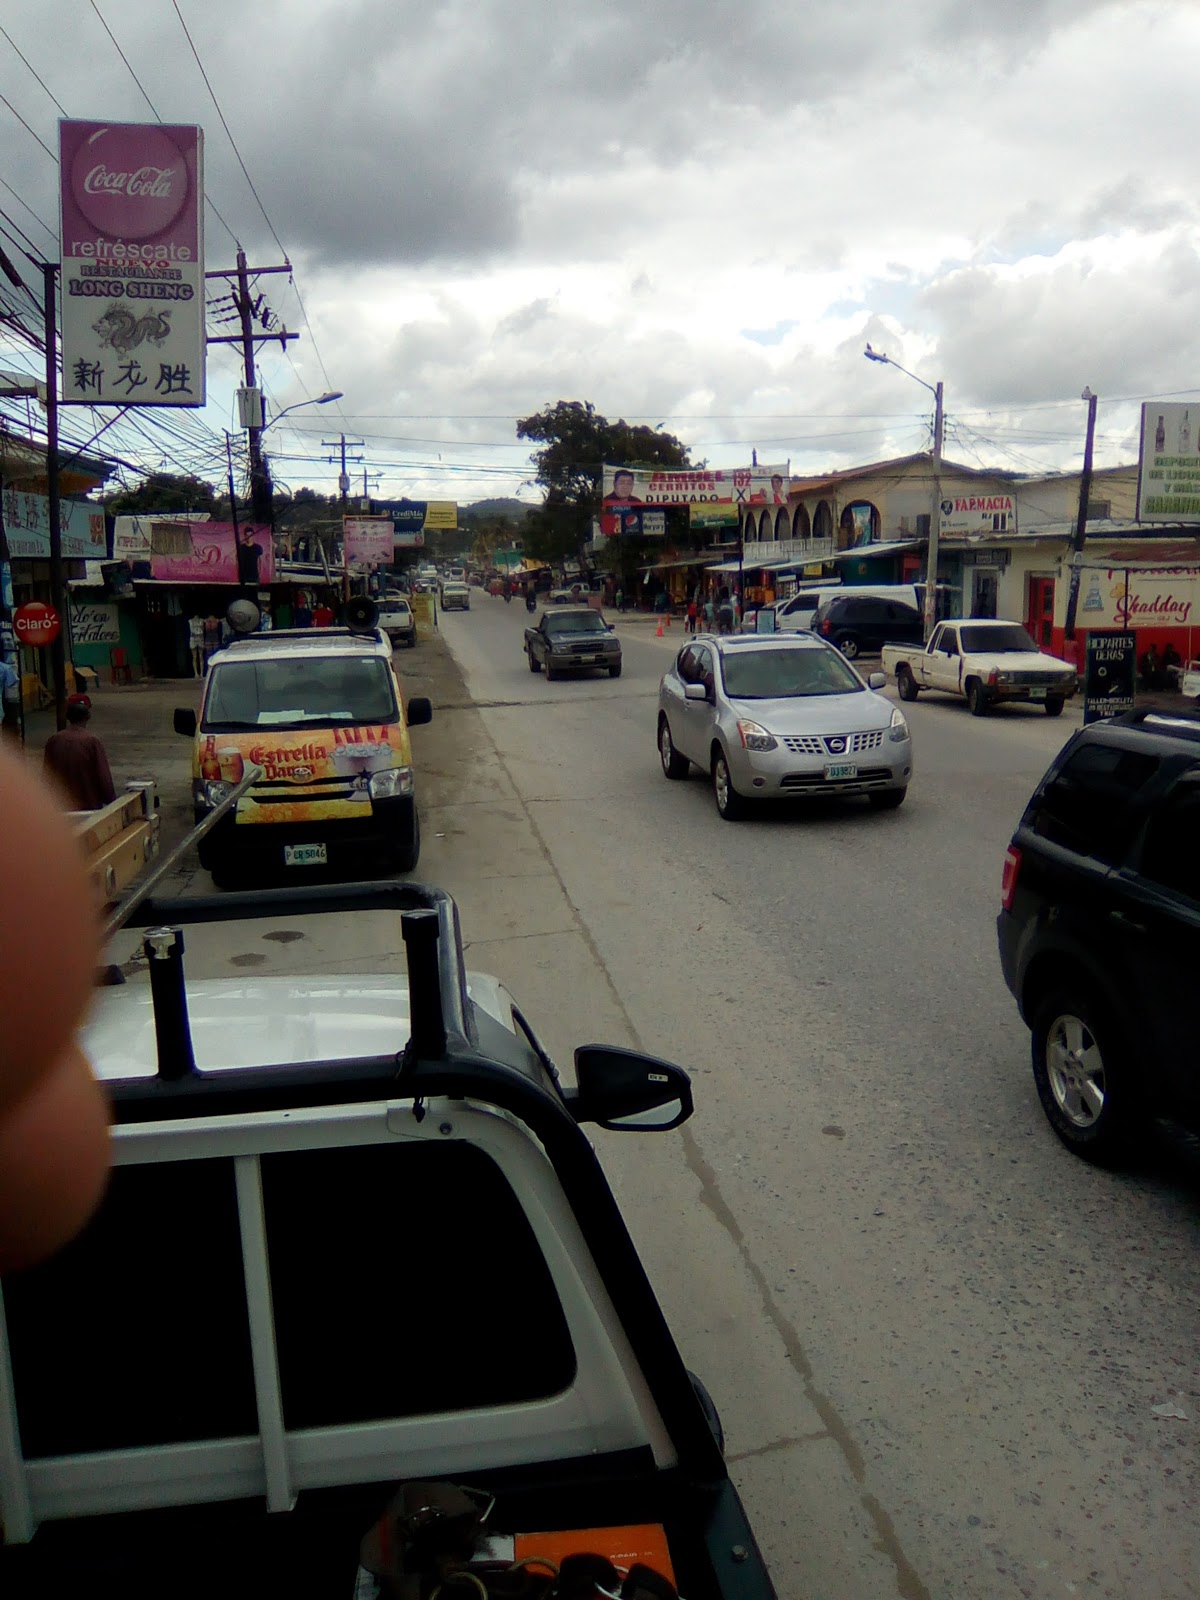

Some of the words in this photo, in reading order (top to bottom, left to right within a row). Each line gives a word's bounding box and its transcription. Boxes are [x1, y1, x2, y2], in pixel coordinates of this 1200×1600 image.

[84, 164, 176, 198] Coca-Cola
[71, 238, 191, 261] refréscate
[95, 258, 170, 268] NUEVO
[80, 265, 182, 280] RESTAURANTE
[69, 279, 124, 298] LONG
[126, 281, 194, 300] SHENG
[645, 494, 719, 503] DIPUTADO
[955, 496, 1013, 512] FARMACIA
[1113, 594, 1193, 623] Shadday
[16, 617, 53, 630] Claro
[249, 743, 328, 766] Estrella
